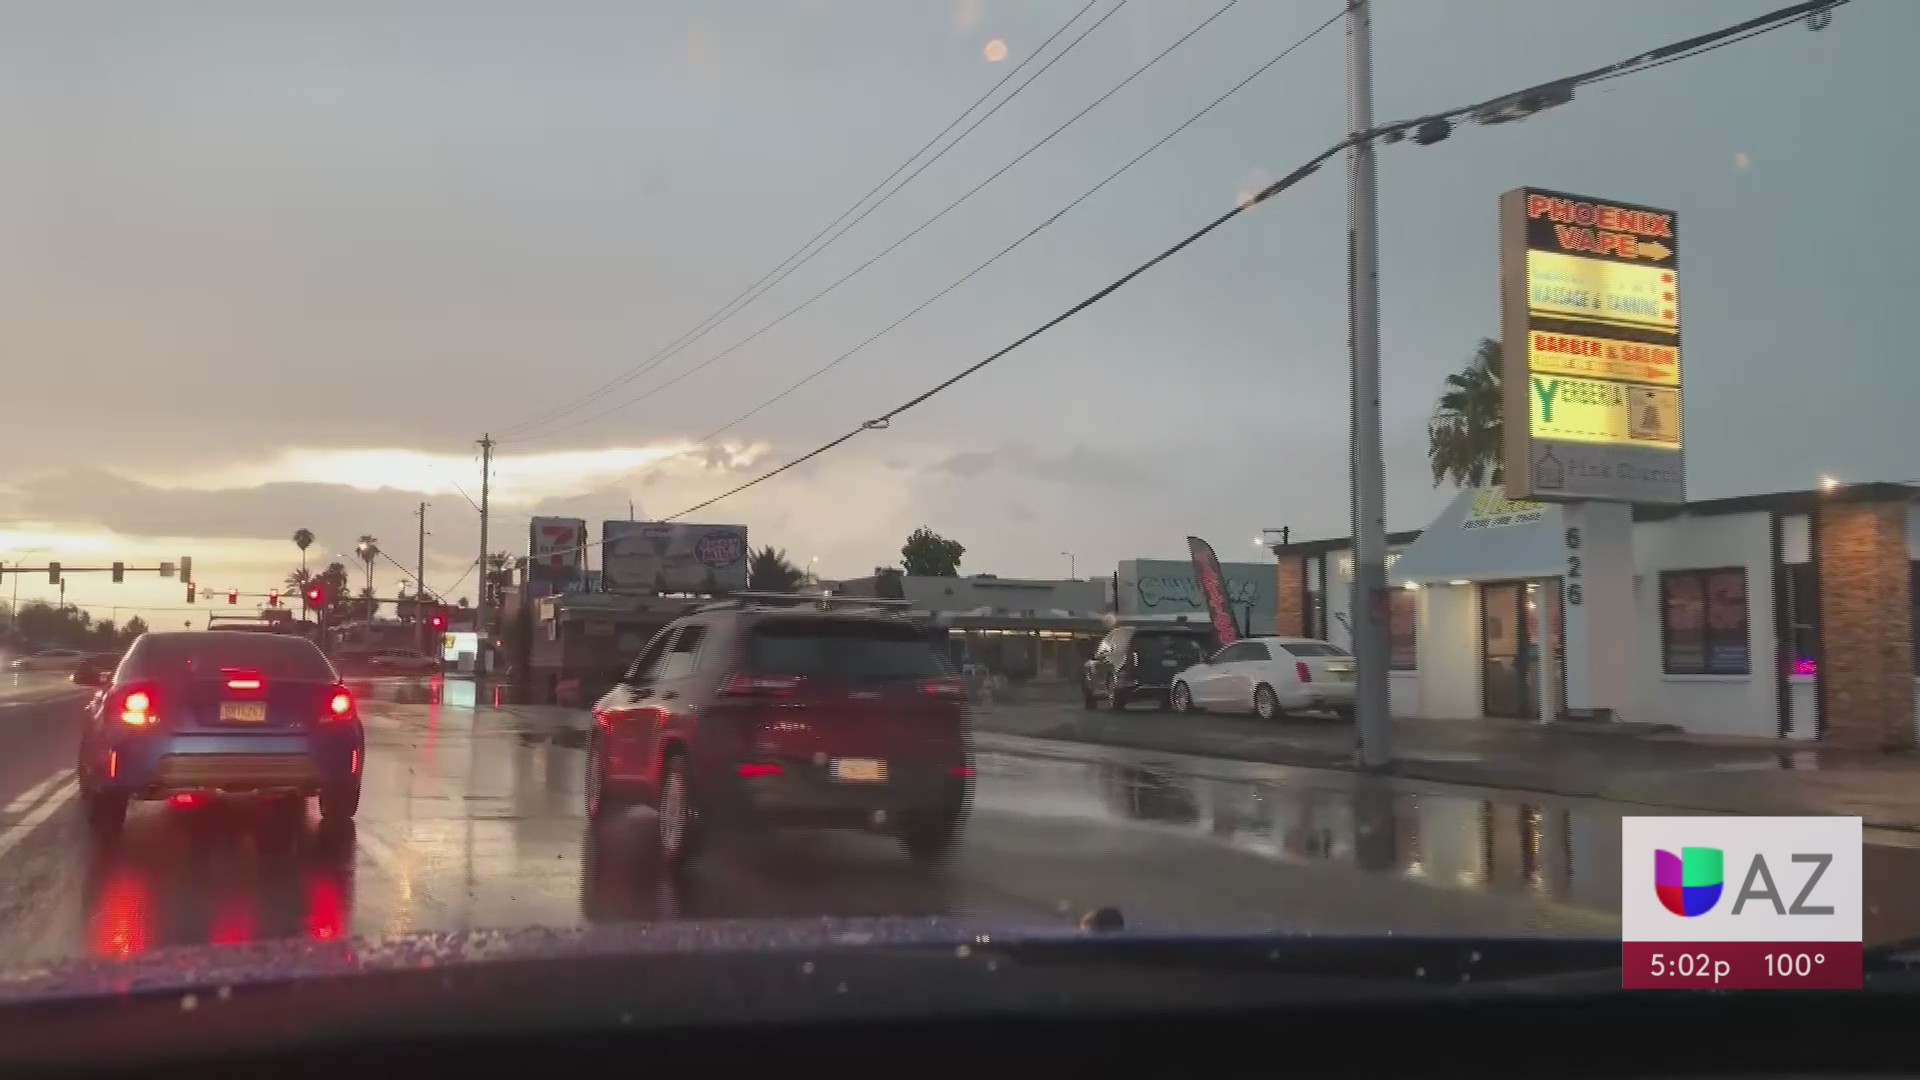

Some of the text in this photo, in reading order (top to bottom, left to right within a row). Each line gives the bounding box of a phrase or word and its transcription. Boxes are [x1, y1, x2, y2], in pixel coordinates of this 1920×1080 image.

[1527, 194, 1672, 238] PHOENIX
[1553, 224, 1639, 260] VAPE
[1532, 285, 1589, 309] MASSAGE
[1606, 294, 1660, 317] TANNING
[1534, 335, 1676, 366] BARBER & SALON
[1532, 377, 1624, 423] YERBERIA
[1568, 457, 1609, 479] Pink
[1564, 527, 1584, 605] 626
